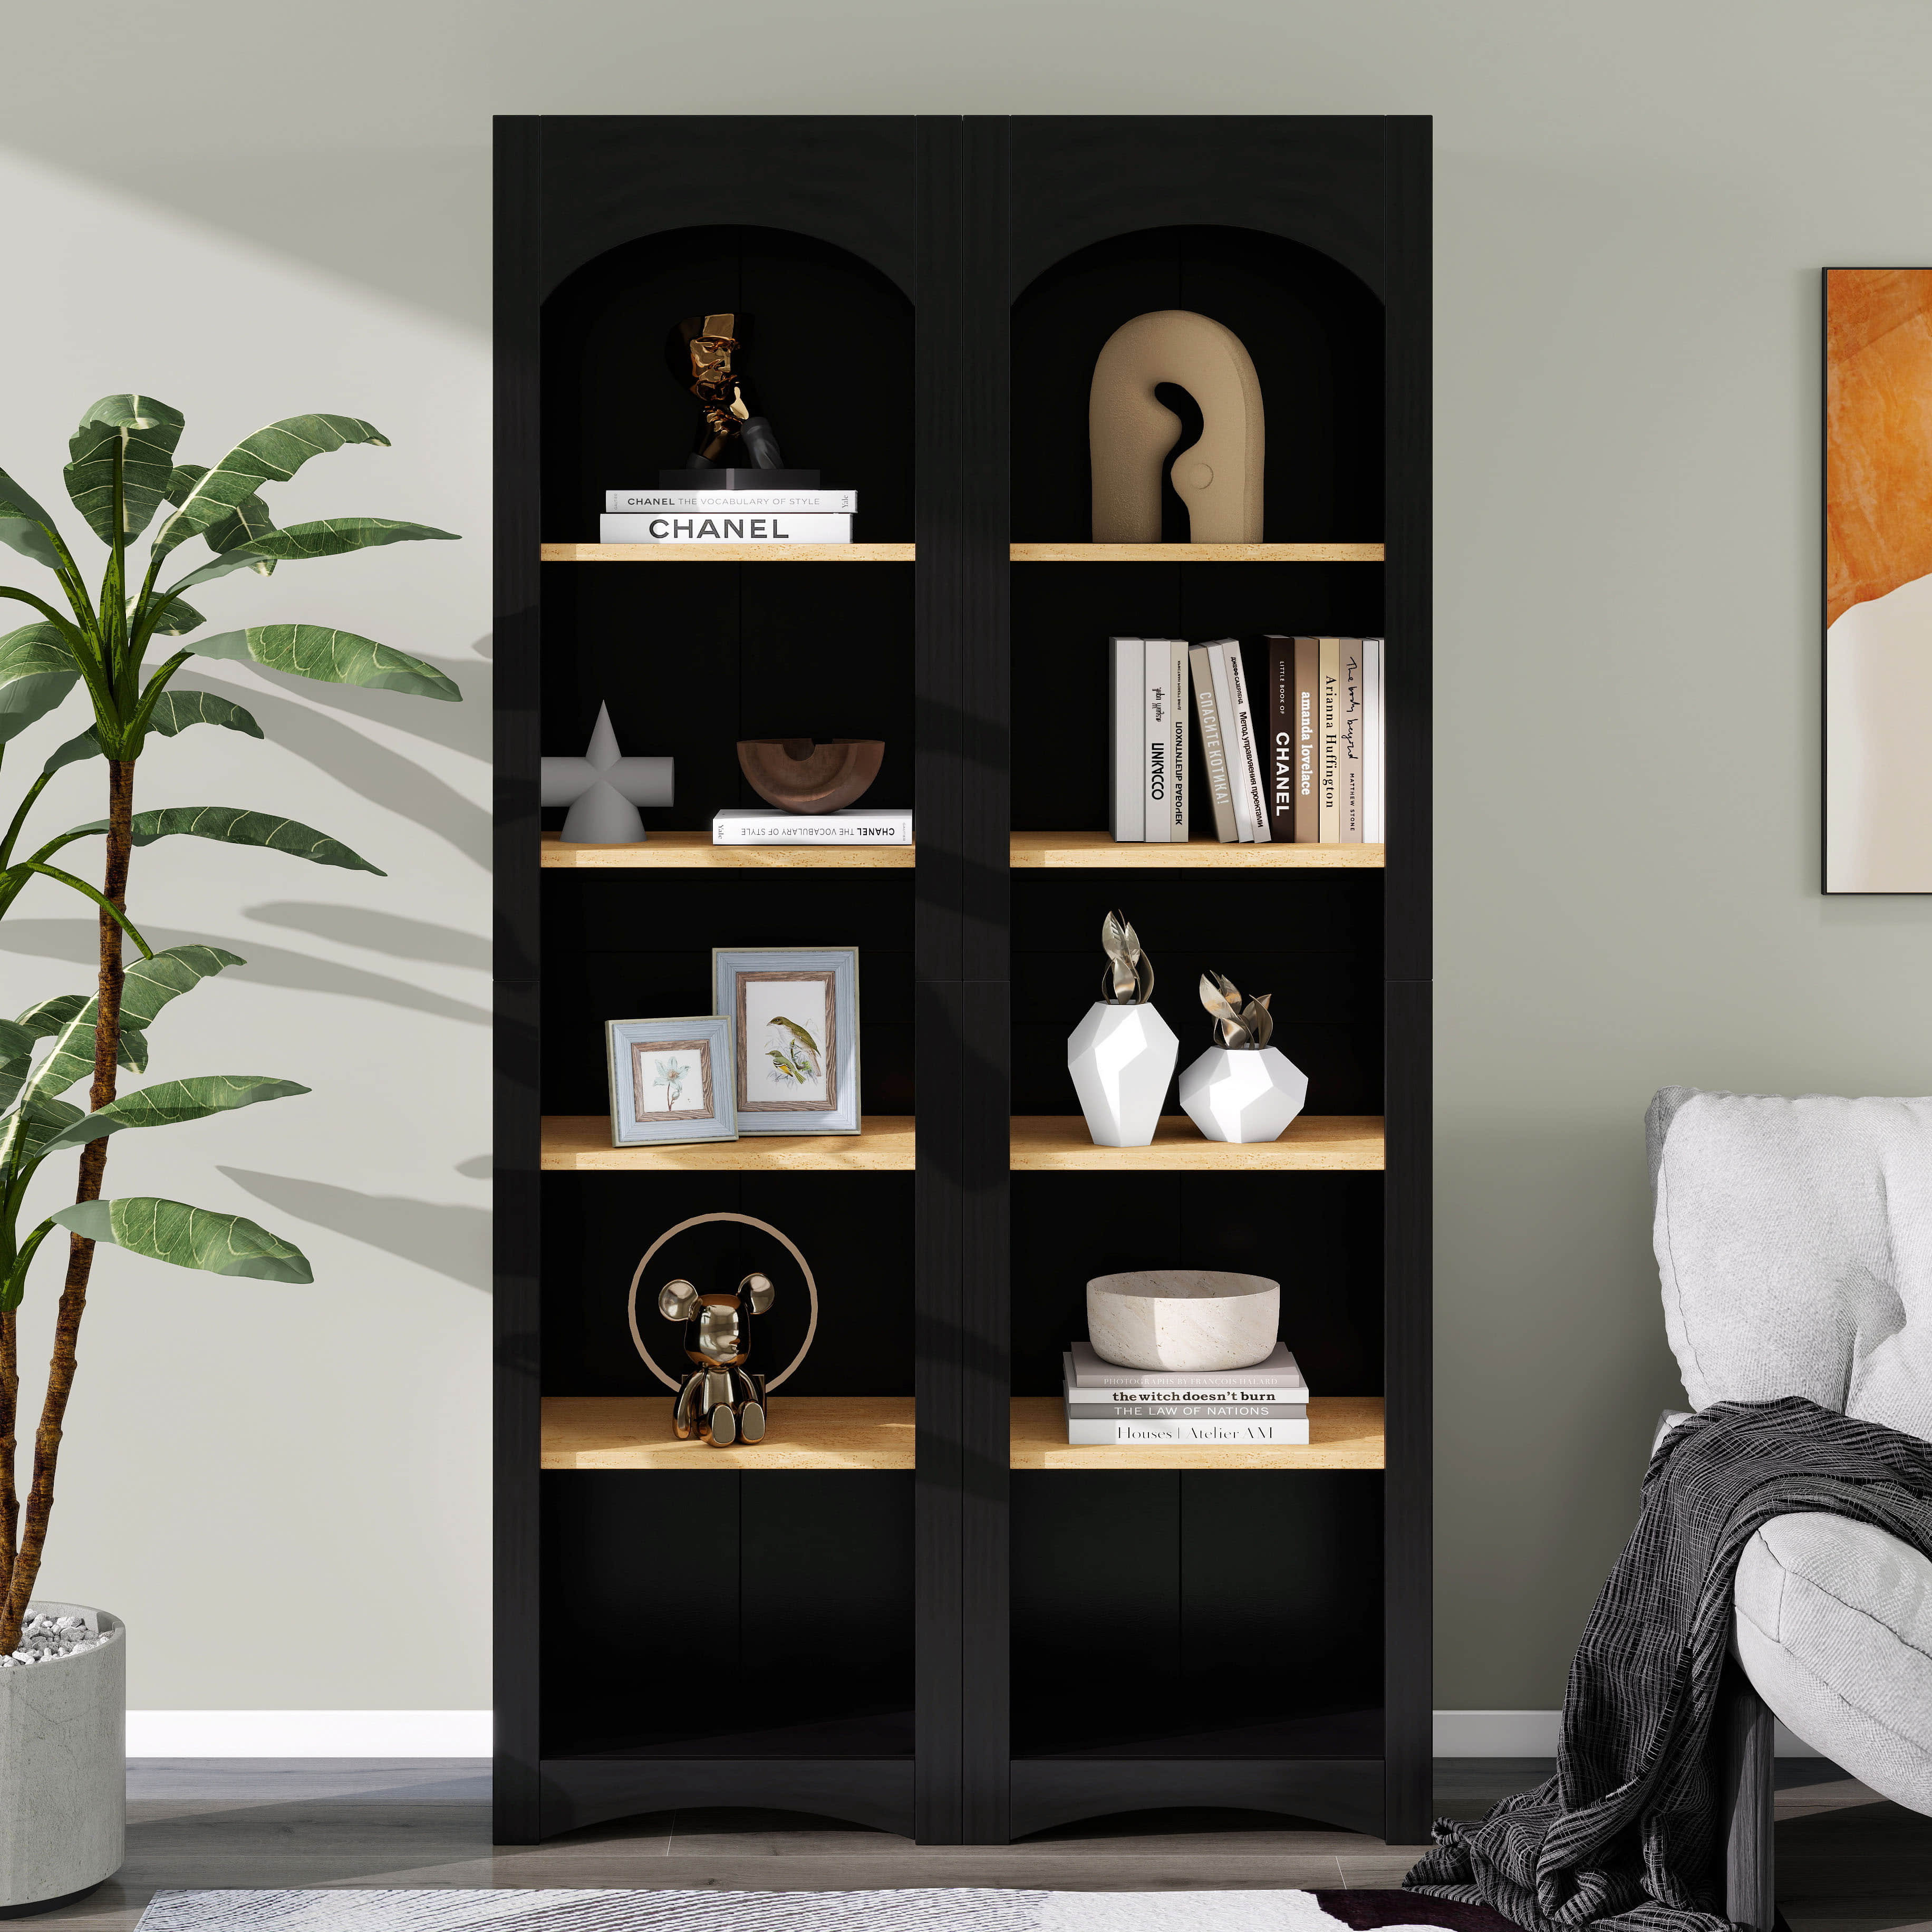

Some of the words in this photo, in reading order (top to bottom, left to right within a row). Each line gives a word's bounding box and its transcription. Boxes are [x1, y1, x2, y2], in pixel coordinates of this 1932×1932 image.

[649, 519, 789, 538] CHANEL
[1346, 656, 1358, 682] The
[1234, 677, 1243, 704] САЗЕРЛЕНД
[1326, 675, 1337, 729] Arianna
[1346, 686, 1360, 713] body
[1200, 692, 1220, 747] СПАСИТЕ
[1279, 706, 1285, 714] OF
[1301, 691, 1313, 741] amanda
[1341, 718, 1359, 759] beyond
[1209, 751, 1229, 805] КОТИКА!
[1239, 711, 1249, 737] Метод
[1250, 786, 1264, 827] проектами
[1276, 732, 1290, 816] CHANEL
[1301, 744, 1313, 795] lovelace
[1323, 734, 1337, 808] Huffington
[1113, 1392, 1137, 1401] the
[1139, 1392, 1181, 1401] witch
[1241, 1392, 1276, 1401] burn
[1191, 1377, 1237, 1386] FRANÇOIS
[1114, 1407, 1142, 1415] THE
[1148, 1407, 1177, 1415] LAW
[1183, 1407, 1201, 1415] OF
[1208, 1407, 1269, 1415] NATIONS
[1117, 1427, 1172, 1439] Houses
[1186, 1427, 1240, 1439] Atelier
[1244, 1427, 1273, 1439] AM
